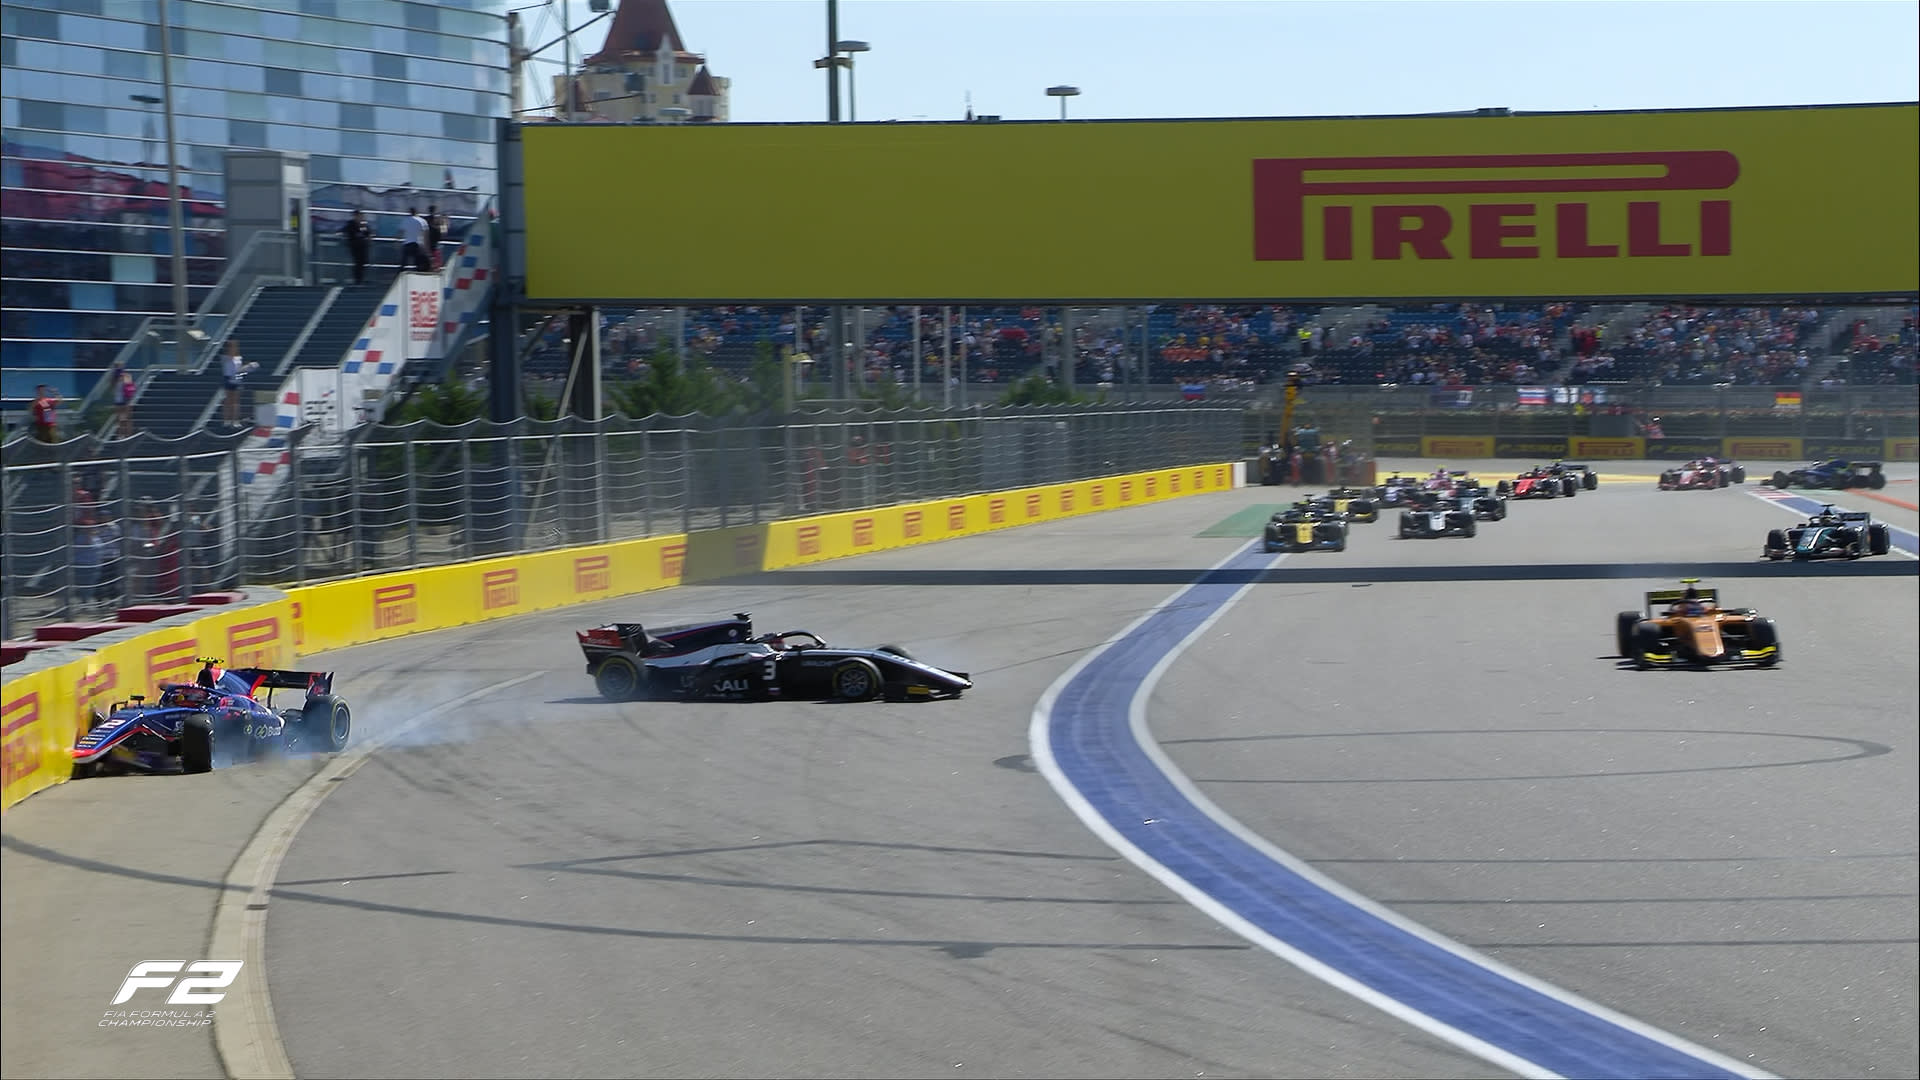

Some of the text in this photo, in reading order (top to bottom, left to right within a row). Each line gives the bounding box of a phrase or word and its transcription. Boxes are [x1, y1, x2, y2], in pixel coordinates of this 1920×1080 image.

[1253, 150, 1740, 261] PIRELLI
[761, 660, 777, 681] 3
[98, 719, 126, 729] 2
